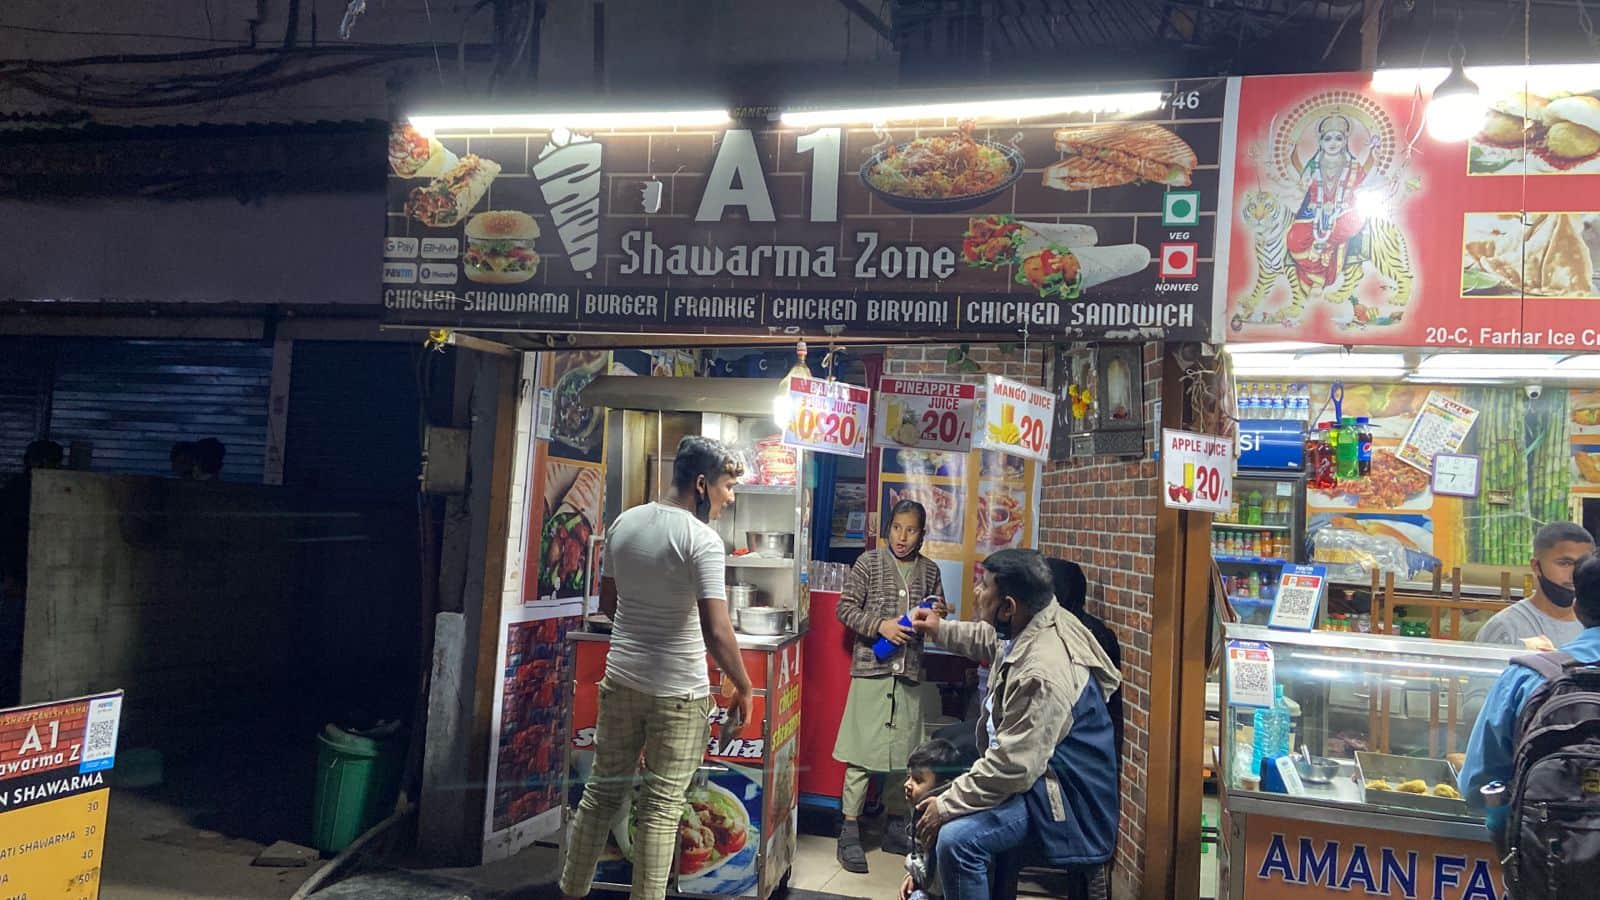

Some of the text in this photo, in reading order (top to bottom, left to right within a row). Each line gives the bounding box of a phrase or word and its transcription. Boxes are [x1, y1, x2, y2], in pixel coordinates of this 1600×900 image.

[1169, 232, 1190, 240] VEG
[620, 230, 956, 279] Shawarma Zone
[1154, 283, 1199, 292] NONVEG
[384, 289, 569, 314] CHICKEN SHAWARMA
[585, 293, 658, 316] BURGER
[674, 296, 755, 319] FRANKIE
[772, 297, 948, 324] CHICKEN BIRYANI
[967, 301, 1194, 327] CHICKEN SANDWICH
[1426, 327, 1472, 346] 20-C,
[1480, 328, 1542, 345] Farhar
[1548, 329, 1576, 345] Ice
[894, 381, 961, 397] PINEAPPLE
[993, 383, 1051, 410] MANGO JUICE
[831, 400, 857, 416] JUICE
[928, 397, 960, 410] JUICE
[1171, 437, 1226, 456] APPLE JUICE
[13, 771, 104, 805] SHAWARMA
[84, 825, 96, 837] 30
[19, 831, 76, 855] SHAWARMA
[1257, 832, 1508, 900] AMAN FA
